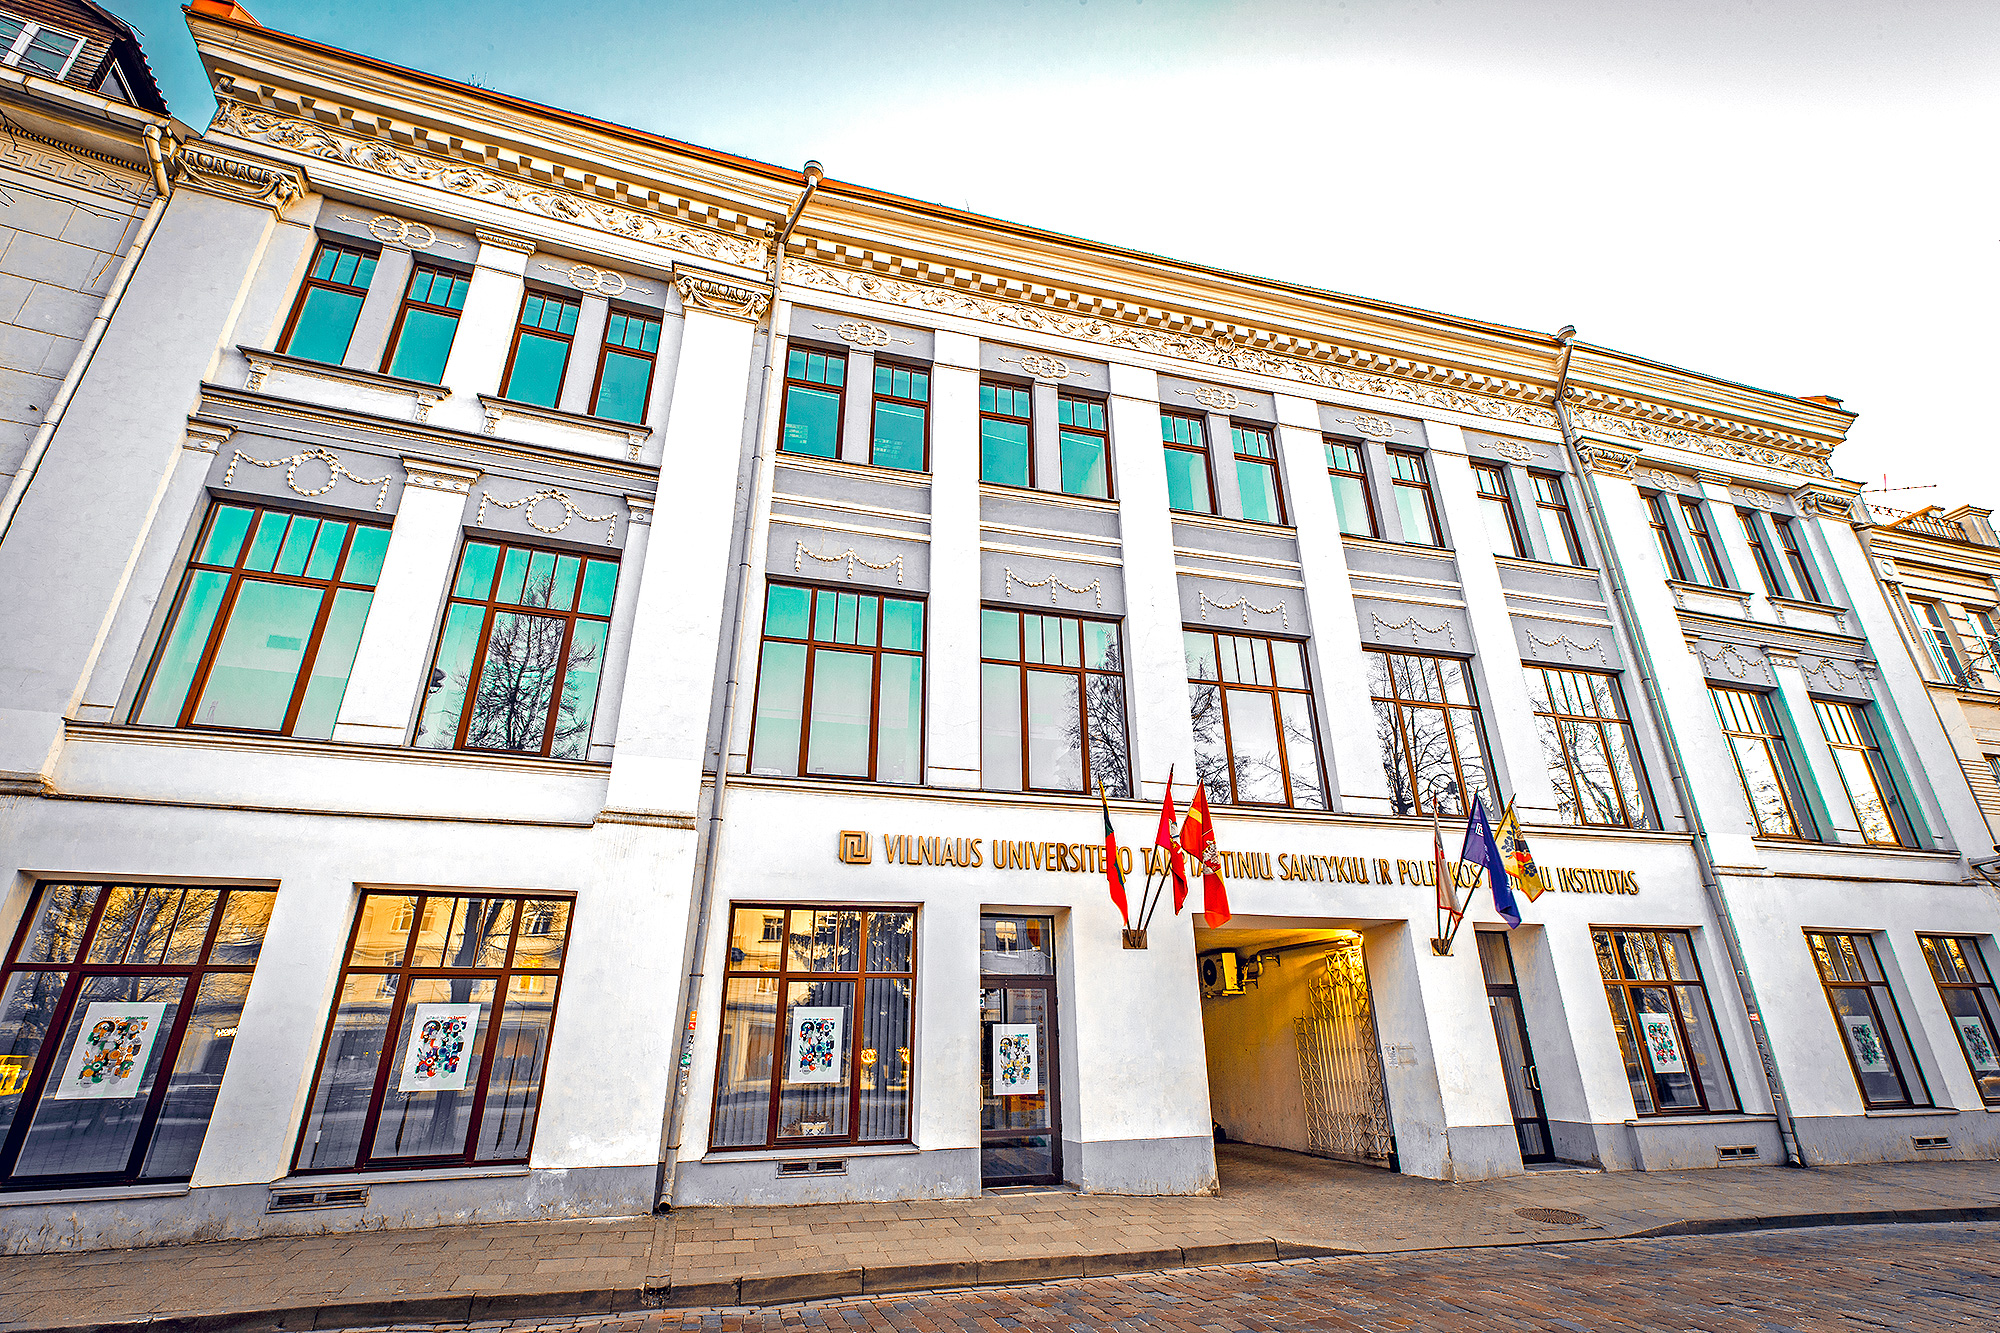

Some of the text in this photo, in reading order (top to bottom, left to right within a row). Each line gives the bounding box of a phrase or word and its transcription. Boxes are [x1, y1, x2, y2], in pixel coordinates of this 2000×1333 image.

[884, 834, 983, 868] VILNIAUS
[993, 839, 1133, 875] UNIVERSITEO
[1278, 852, 1369, 885] SANTYKIŲ
[1372, 858, 1394, 885] IR
[1396, 859, 1483, 888] POLIKOS
[1556, 867, 1640, 896] INSTITUTAS
